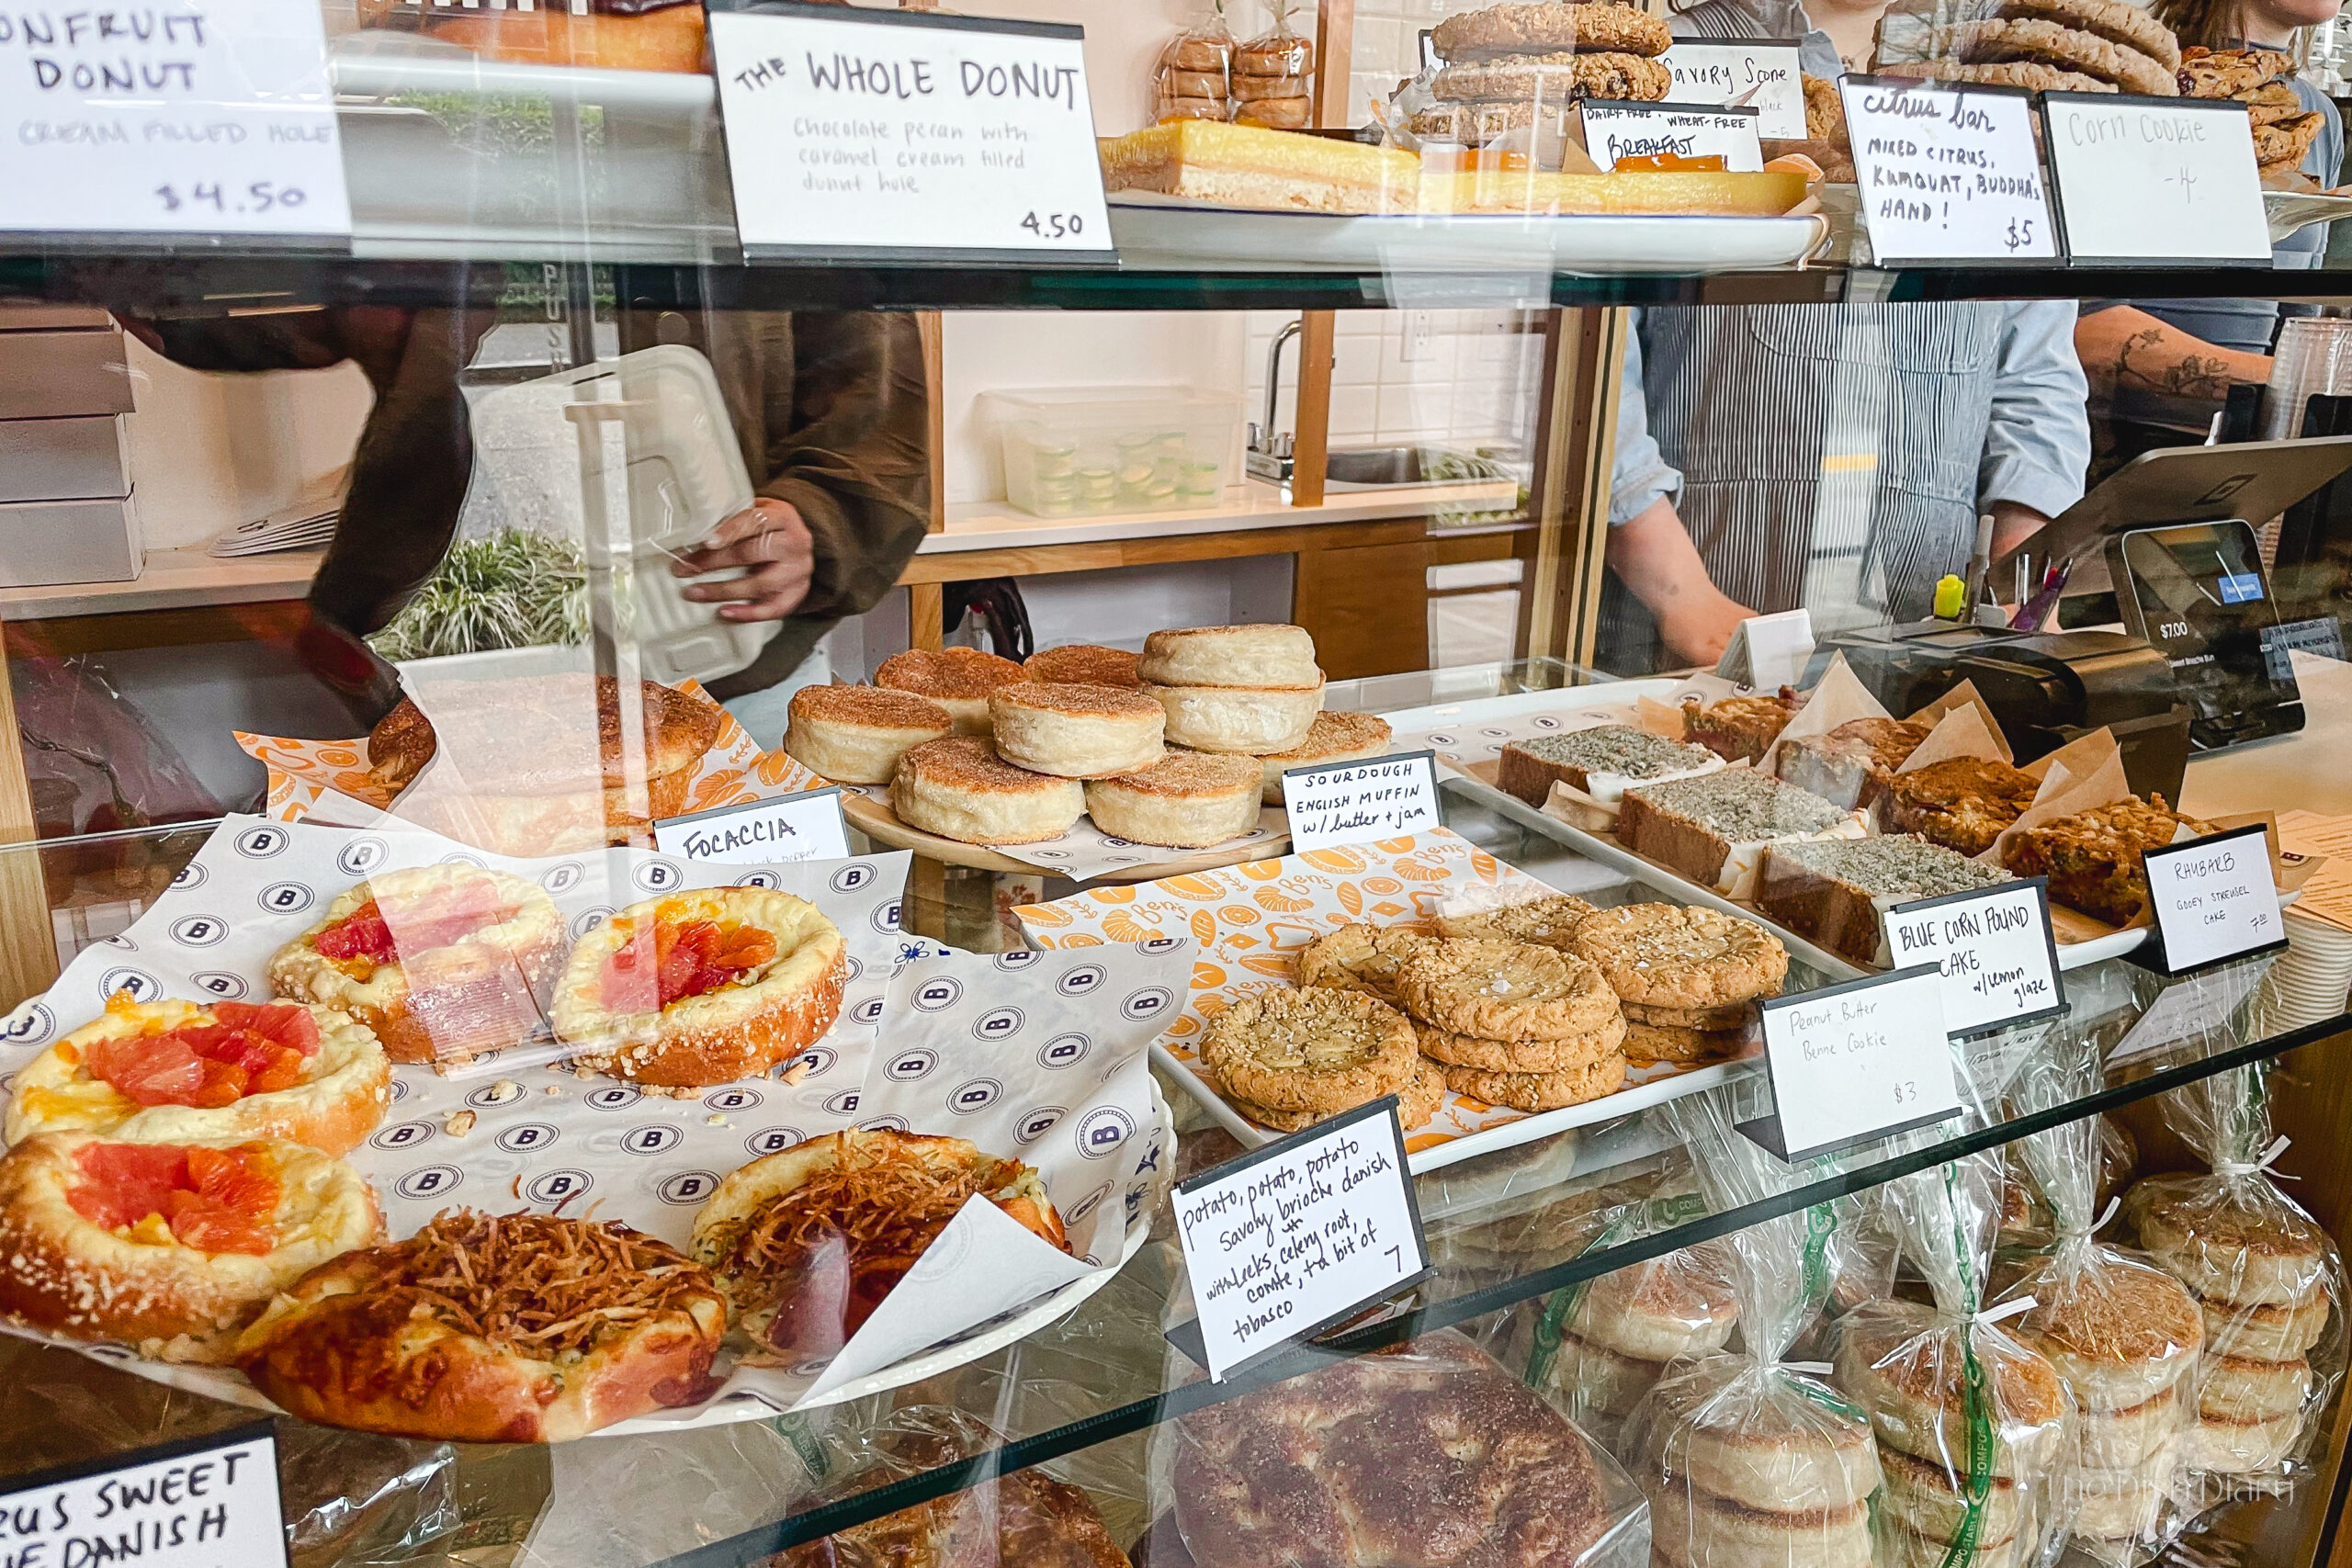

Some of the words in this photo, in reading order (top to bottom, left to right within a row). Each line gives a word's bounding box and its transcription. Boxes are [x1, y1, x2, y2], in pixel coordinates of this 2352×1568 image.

[34, 58, 197, 91] DONUT
[735, 57, 787, 93] THE
[806, 51, 934, 99] WHOLE
[960, 61, 1080, 110] DONUT
[1745, 57, 1788, 84] Scone
[1863, 90, 1941, 119] citrus
[1948, 93, 1996, 132] bar
[18, 120, 130, 145] CREAM
[143, 123, 247, 144] FILLED
[268, 125, 334, 144] HOLE
[904, 121, 965, 144] pecan
[981, 121, 1028, 142] with
[2069, 113, 2125, 147] Corn
[2139, 114, 2206, 144] Cookie
[798, 148, 878, 167] caramel
[897, 152, 965, 168] cream
[980, 148, 1025, 169] filled
[1608, 134, 1697, 164] BREAKFAST
[878, 175, 920, 194] hole
[155, 182, 307, 212] $4.50
[1020, 211, 1083, 238] 4.50
[2005, 217, 2033, 253] $5
[2160, 622, 2188, 640] $7.00
[1305, 763, 1412, 788] SOURDOUGH
[1296, 795, 1351, 814] ENGLISH
[1359, 784, 1419, 806] MUFFIN
[1396, 806, 1426, 829] jam
[250, 834, 271, 850] B
[683, 818, 797, 860] FOCACCIA
[352, 847, 372, 865] B
[2174, 852, 2235, 882] RHUBARB
[552, 870, 570, 887] B
[650, 867, 665, 884] B
[845, 871, 861, 886] B
[1278, 874, 1334, 896] Ben's
[275, 890, 296, 906] B
[2177, 897, 2202, 911] GOOEY
[2211, 886, 2250, 903] STREUSEL
[1132, 900, 1189, 925] Ben's
[2203, 910, 2226, 926] CAKE
[186, 922, 209, 938] B
[1898, 921, 1937, 952] BLUE
[1944, 912, 1981, 945] CORN
[1984, 906, 2029, 935] POUND
[1939, 950, 1980, 977] CAKE
[207, 979, 229, 992] B
[1069, 975, 1092, 987] B
[923, 988, 948, 998] B
[1134, 998, 1159, 1010] B
[2014, 979, 2048, 1008] glaze
[985, 1019, 1011, 1031] B
[1789, 1010, 1832, 1036] Peanut
[1841, 1000, 1878, 1021] Butter
[1050, 1045, 1076, 1057] B
[1803, 1040, 1838, 1062] Benne
[1847, 1032, 1887, 1054] Cookie
[898, 1061, 924, 1072] B
[603, 1091, 625, 1101] B
[723, 1096, 743, 1106] B
[841, 1096, 857, 1111] B
[961, 1090, 988, 1103] B
[1894, 1081, 1917, 1104] $3
[389, 1129, 414, 1142] B
[515, 1130, 538, 1145] B
[1028, 1119, 1055, 1134] B
[1092, 1126, 1119, 1145] B
[639, 1132, 662, 1147] B
[764, 1134, 785, 1149] B
[1306, 1137, 1360, 1187] potato
[416, 1173, 441, 1190] B
[548, 1178, 571, 1194] B
[677, 1179, 700, 1196] B
[1275, 1179, 1334, 1221] brioche
[1341, 1151, 1391, 1193] danish
[1280, 1232, 1324, 1265] celery
[1333, 1235, 1356, 1263] bit
[1361, 1218, 1378, 1248] of
[1384, 1245, 1402, 1273] 7
[1232, 1300, 1294, 1344] tobasco
[96, 1452, 250, 1517] SWEET
[63, 1504, 228, 1568] DANISH
